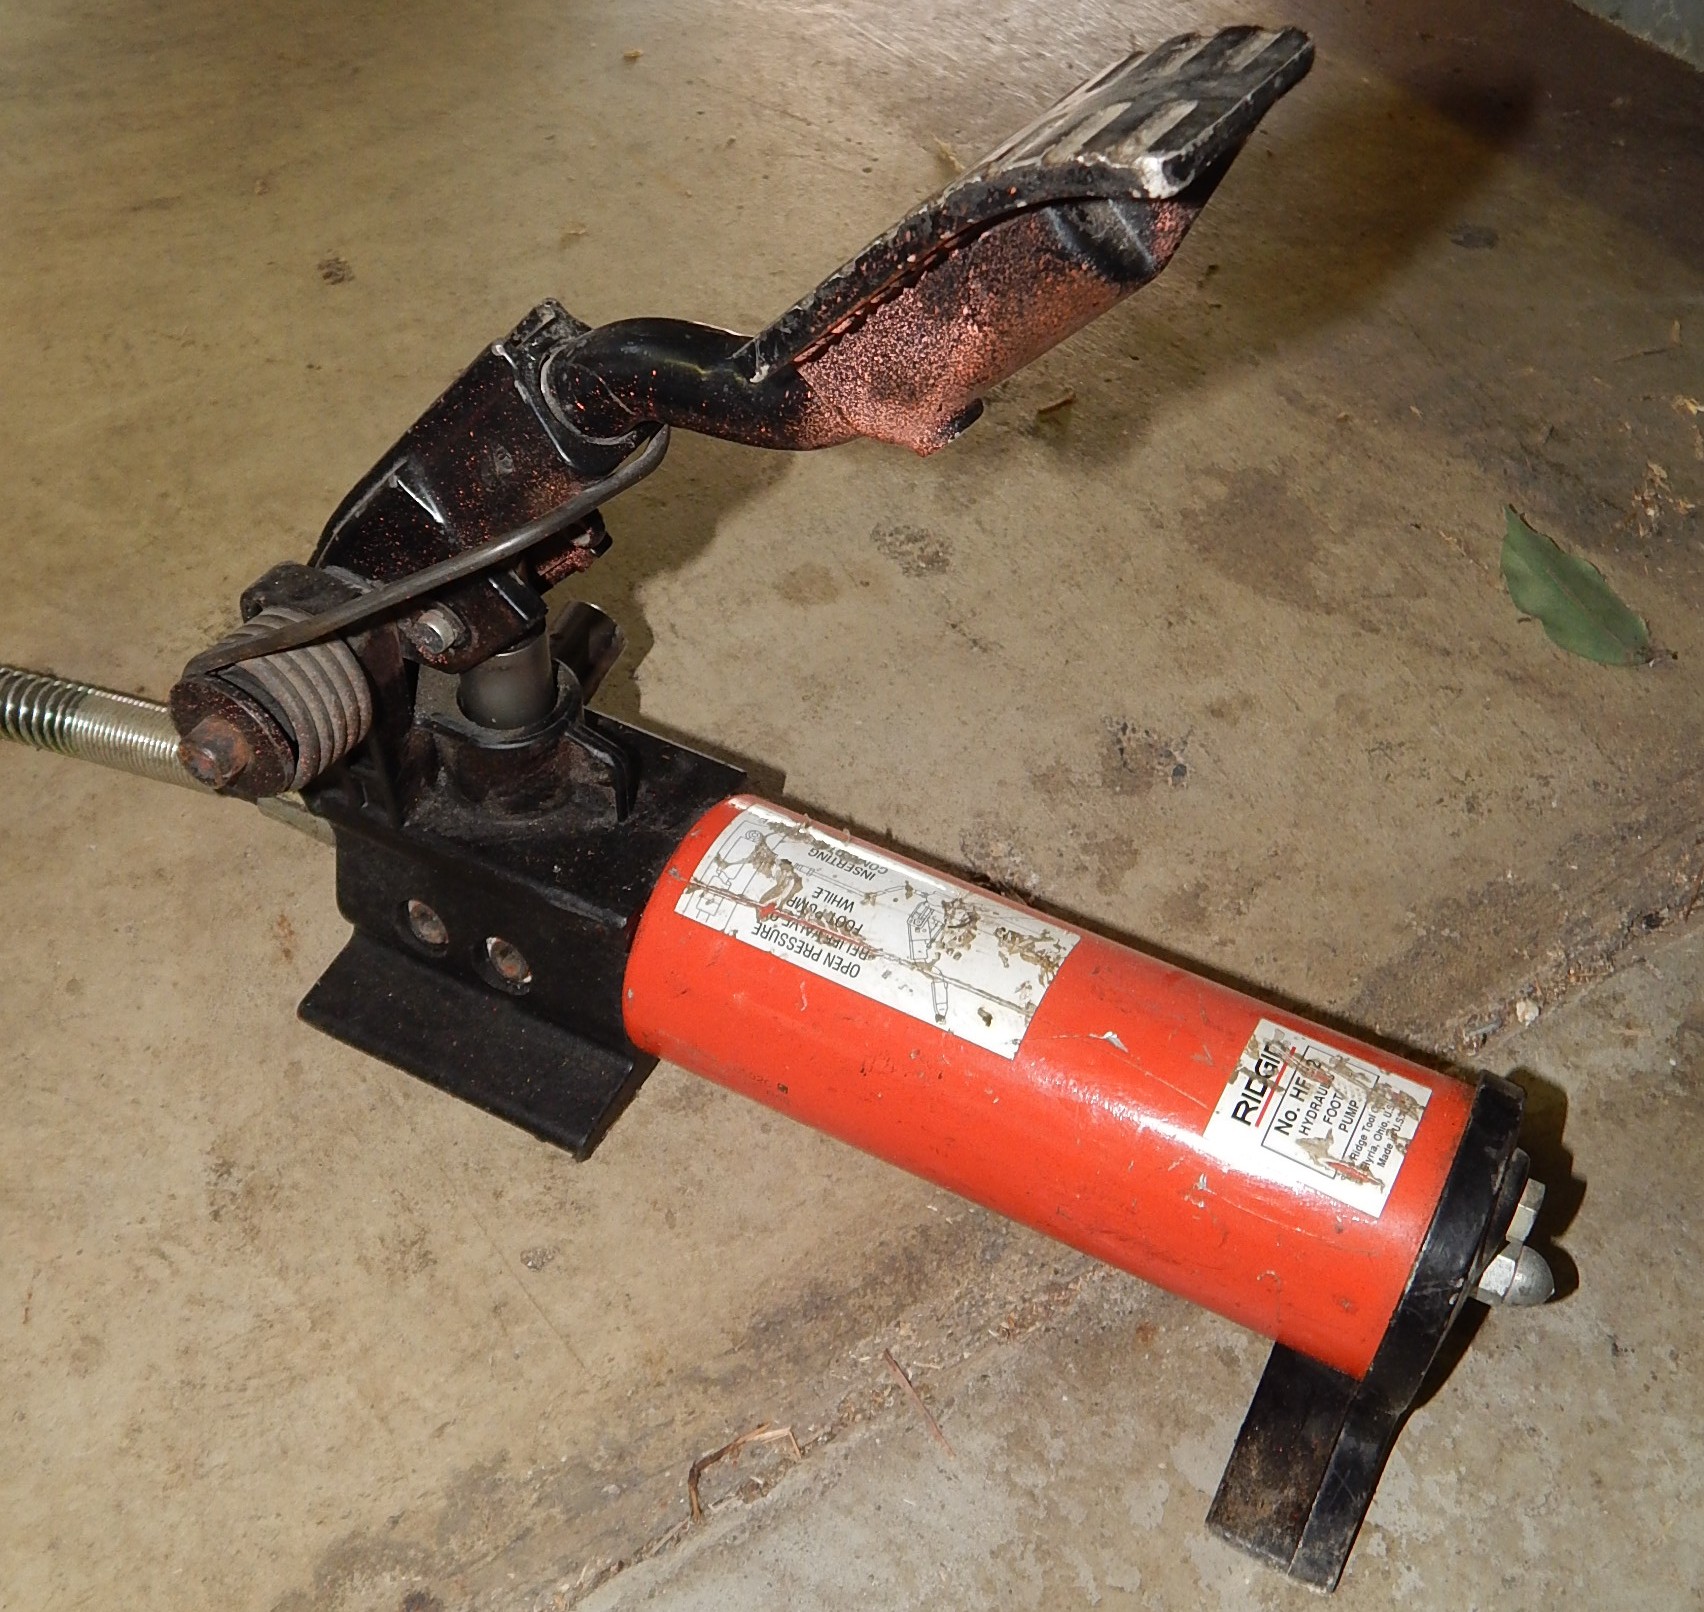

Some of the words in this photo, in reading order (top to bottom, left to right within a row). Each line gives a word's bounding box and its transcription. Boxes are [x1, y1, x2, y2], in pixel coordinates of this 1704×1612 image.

[807, 847, 876, 880] INSERTING
[812, 886, 855, 913] WHILE
[830, 911, 863, 936] FOOT
[751, 924, 823, 962] PRESSURE
[823, 952, 861, 978] OPEN
[1274, 1107, 1301, 1136] No.
[1322, 1093, 1344, 1125] FOOT
[1338, 1100, 1360, 1133] PUMP
[1350, 1134, 1368, 1161] Ridge
[1362, 1113, 1376, 1133] Tool
[1373, 1121, 1390, 1141] Ohio,
[1377, 1142, 1394, 1167] Made
